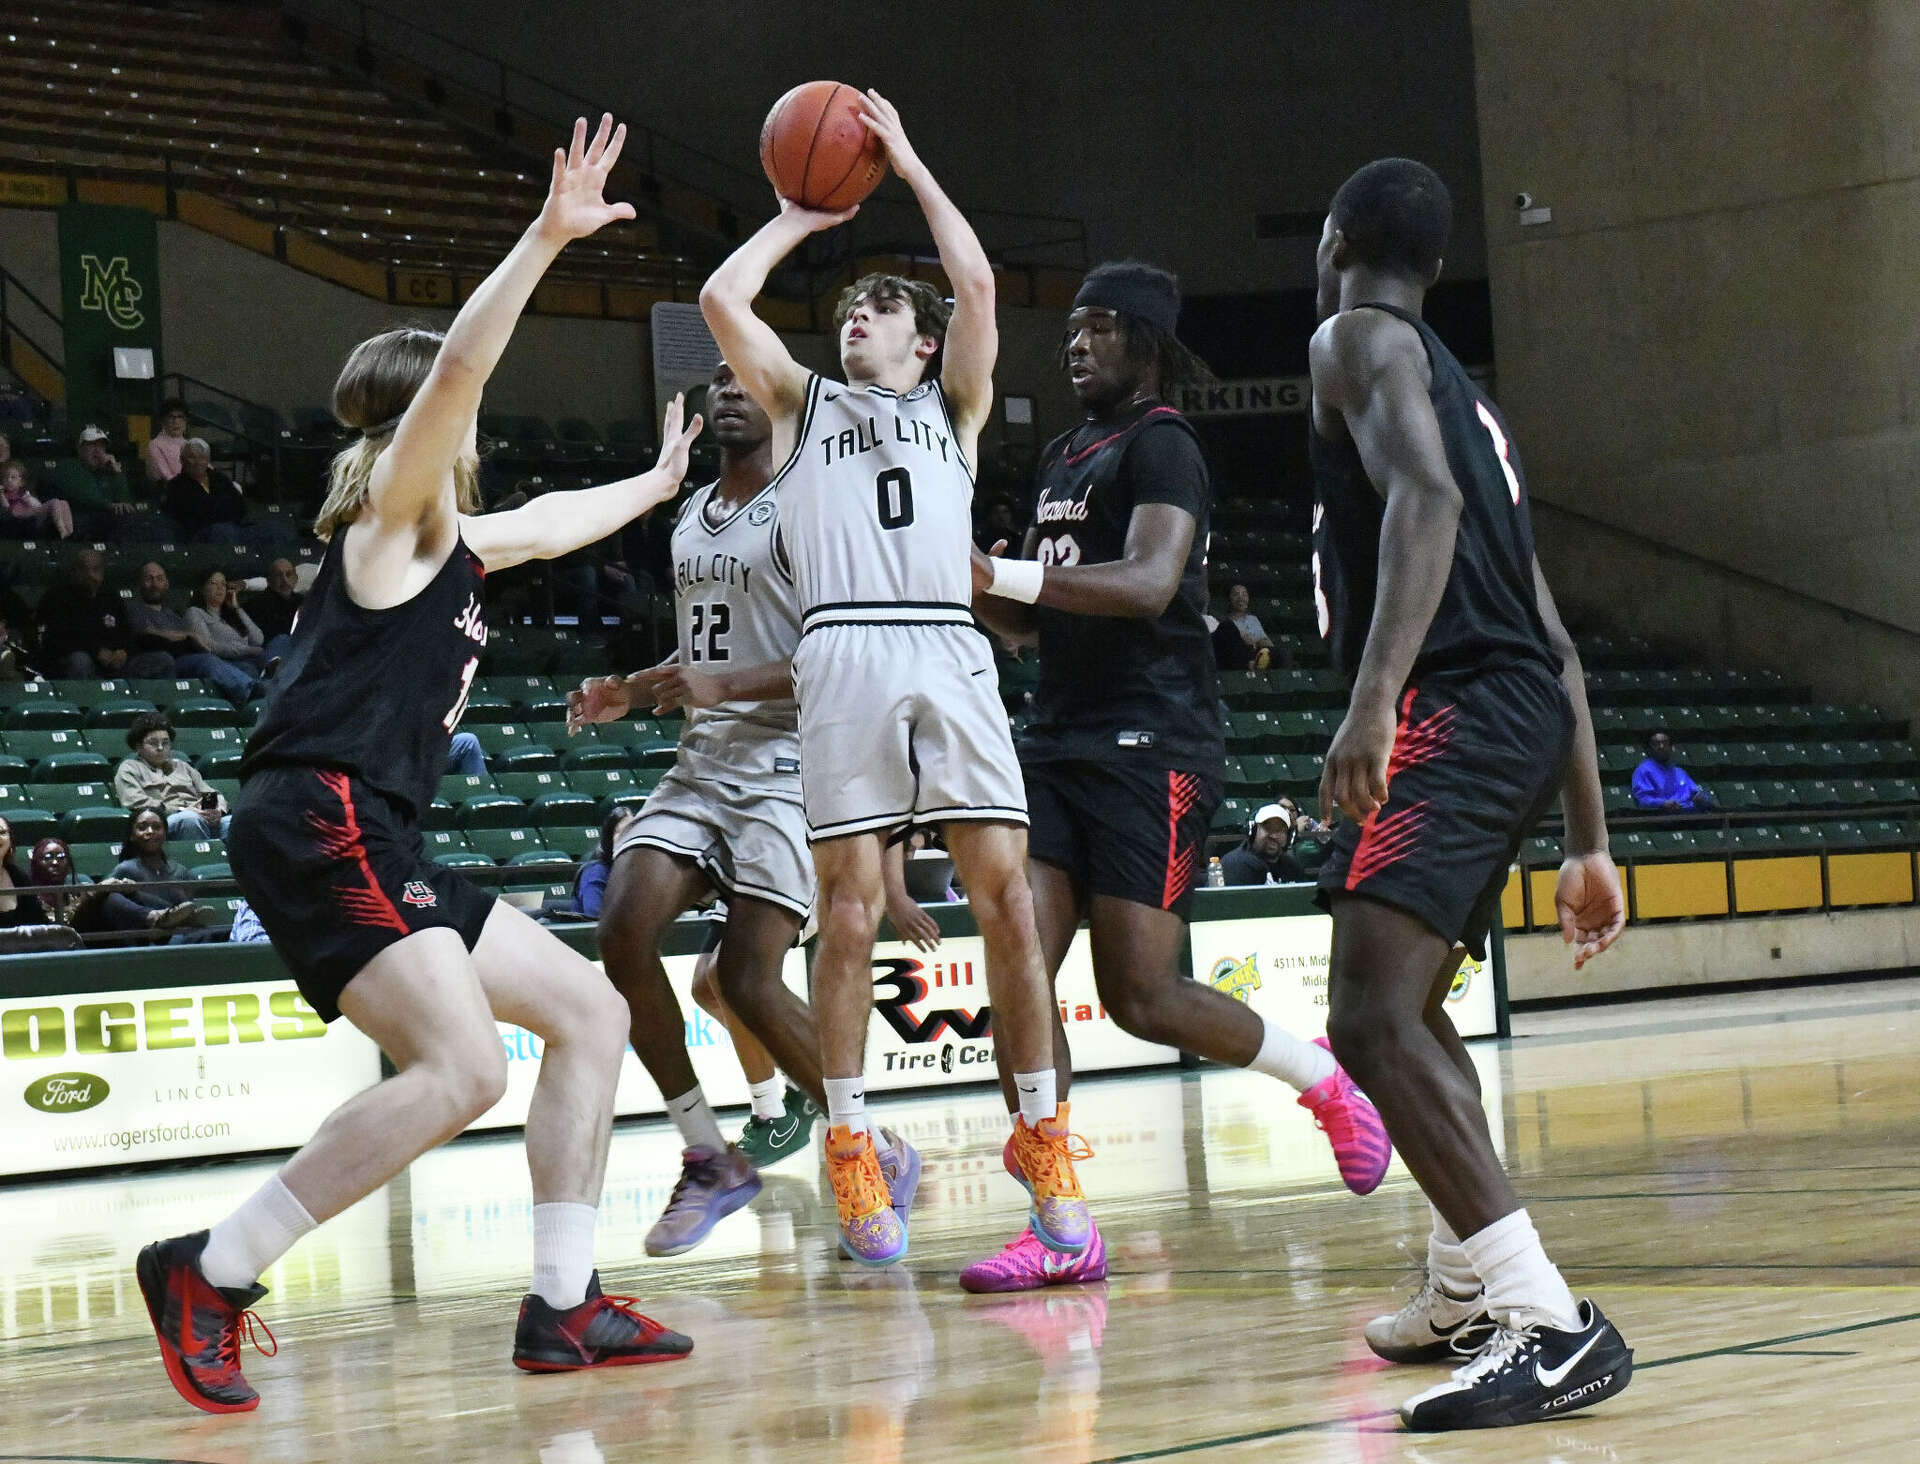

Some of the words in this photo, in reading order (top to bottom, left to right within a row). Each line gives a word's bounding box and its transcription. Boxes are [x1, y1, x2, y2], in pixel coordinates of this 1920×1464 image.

[1182, 383, 1299, 411] RKING
[821, 416, 883, 466] TALL
[876, 467, 914, 530] 0
[711, 553, 751, 593] CITY
[691, 603, 730, 661] 22
[1273, 957, 1295, 969] 4511
[872, 957, 974, 1007] Bill
[1302, 975, 1328, 988] Midla
[1, 990, 328, 1061] OGERS
[883, 1051, 936, 1071] Tire
[42, 1078, 92, 1107] Ford
[154, 1081, 251, 1103] LINCOLN
[53, 1119, 231, 1152] www.rogersford.com
